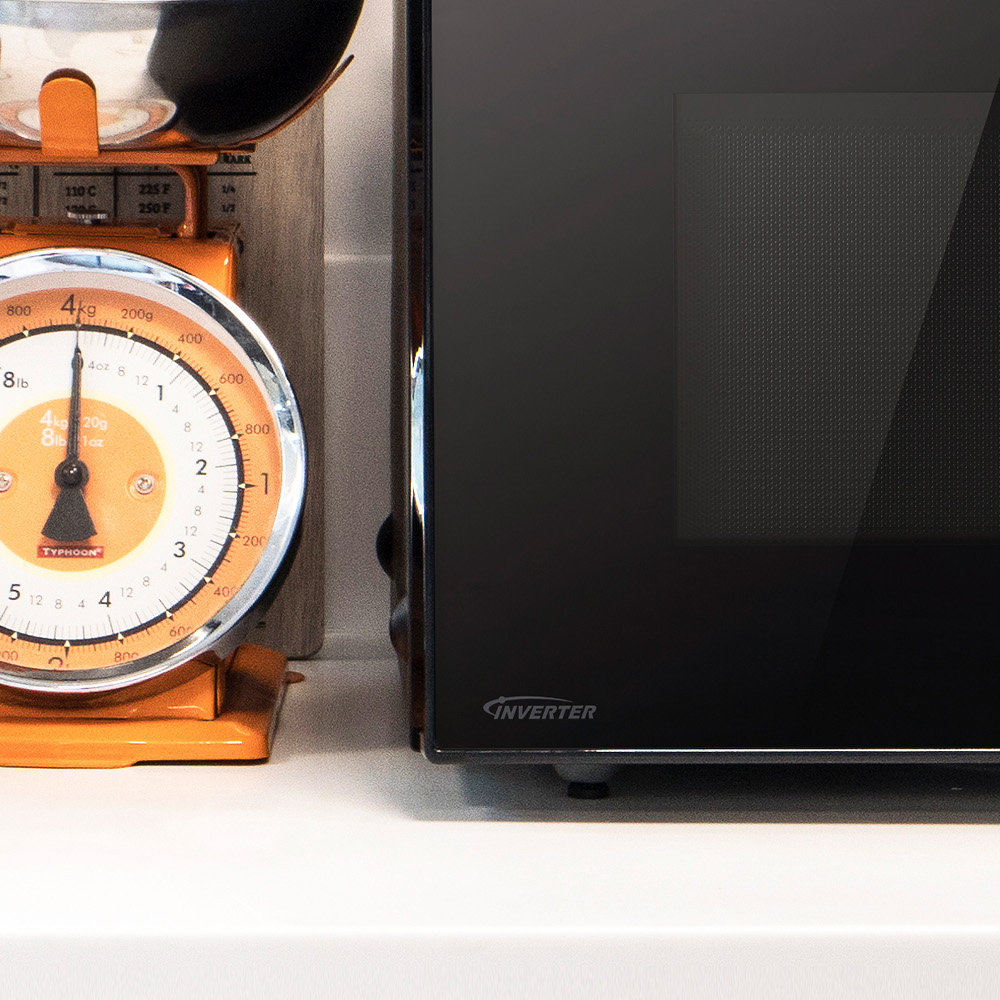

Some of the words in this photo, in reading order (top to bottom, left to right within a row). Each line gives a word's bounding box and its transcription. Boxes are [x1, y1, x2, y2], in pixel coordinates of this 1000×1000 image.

[65, 186, 85, 197] 110
[88, 185, 97, 197] C
[139, 202, 160, 214] 250
[6, 305, 32, 317] 800
[60, 294, 97, 318] 4kg
[121, 308, 154, 322] 200g
[178, 333, 203, 344] 400
[2, 371, 30, 389] 8lb
[136, 375, 149, 387] 12
[219, 373, 244, 385] 600
[157, 384, 164, 401] 1
[172, 404, 179, 414] 4
[40, 410, 69, 430] 4kg
[184, 422, 192, 433] 8
[245, 423, 270, 435] 800
[41, 428, 67, 447] 8lb
[190, 441, 203, 453] 12
[195, 458, 208, 476] 2
[197, 485, 205, 494] 4
[261, 472, 269, 495] 1
[194, 505, 202, 517] 8
[185, 526, 198, 537] 12
[173, 541, 186, 558] 3
[160, 563, 168, 572] 4
[142, 576, 151, 588] 8
[8, 583, 21, 601] 5
[120, 587, 134, 598] 12
[30, 595, 43, 606] 12
[54, 599, 63, 610] 8
[78, 600, 85, 608] 4
[98, 590, 112, 608] 4
[493, 704, 597, 720] INVERTER
